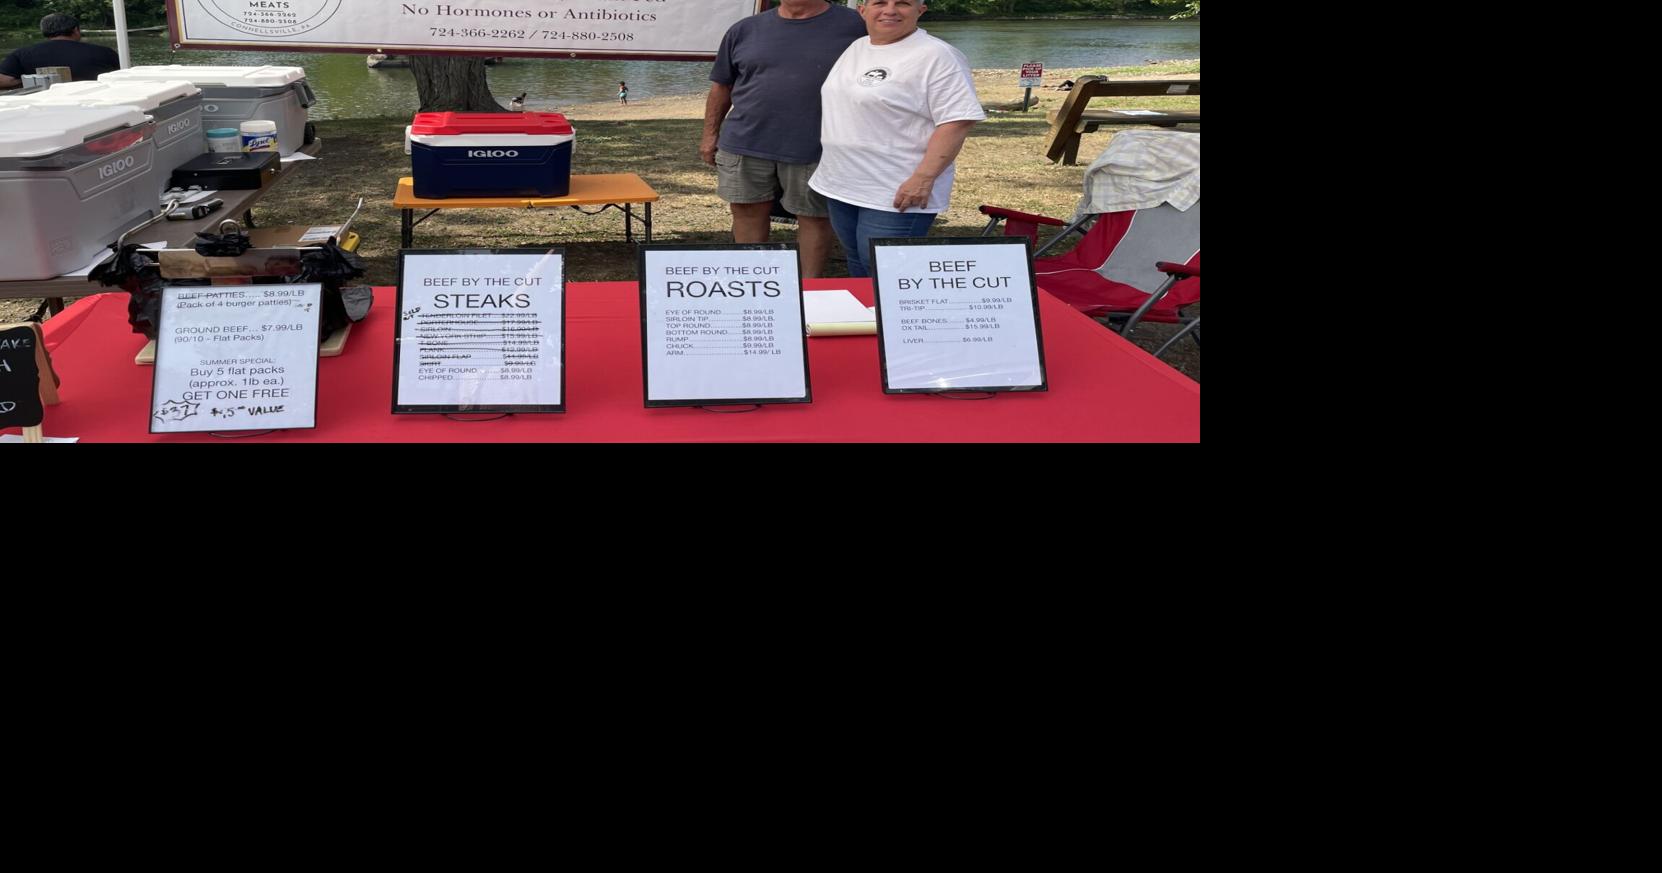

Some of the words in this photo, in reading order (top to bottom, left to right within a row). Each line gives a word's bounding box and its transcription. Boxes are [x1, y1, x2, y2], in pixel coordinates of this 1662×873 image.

[249, 1, 290, 9] MEATS
[402, 3, 429, 15] No
[436, 4, 532, 18] Hormones
[538, 10, 557, 19] or
[563, 8, 657, 21] Antibiotics
[430, 27, 525, 39] 724-366-2262
[542, 30, 634, 41] 724-880-2508
[167, 118, 190, 135] IGLOO
[98, 155, 134, 180] IGLOO
[665, 267, 698, 275] BEEF
[702, 267, 720, 275] BY
[724, 266, 750, 275] THE
[753, 266, 780, 275] CUT
[929, 260, 977, 272] BEEF
[423, 278, 458, 287] BEEF
[462, 278, 480, 286] BY
[484, 278, 511, 286] THE
[514, 277, 543, 286] CUT
[898, 278, 923, 290] BY
[929, 277, 967, 289] THE
[972, 276, 1012, 288] CUT
[264, 290, 304, 298] $8.99/LB
[666, 280, 781, 298] ROASTS
[226, 300, 256, 308] burger
[433, 293, 531, 309] STEAKS
[175, 326, 220, 334] GROUND
[262, 324, 303, 332] $7.99/LB
[233, 334, 264, 342] Packs)
[190, 368, 213, 377] Buy
[228, 367, 246, 375] flat
[250, 366, 284, 376] packs
[189, 379, 237, 389] (approx.
[243, 378, 260, 386] 1lb
[263, 377, 284, 386] ea.)
[182, 391, 213, 400] GET
[216, 390, 248, 399] ONE
[252, 388, 290, 398] FREE
[248, 405, 285, 416] VALUE
